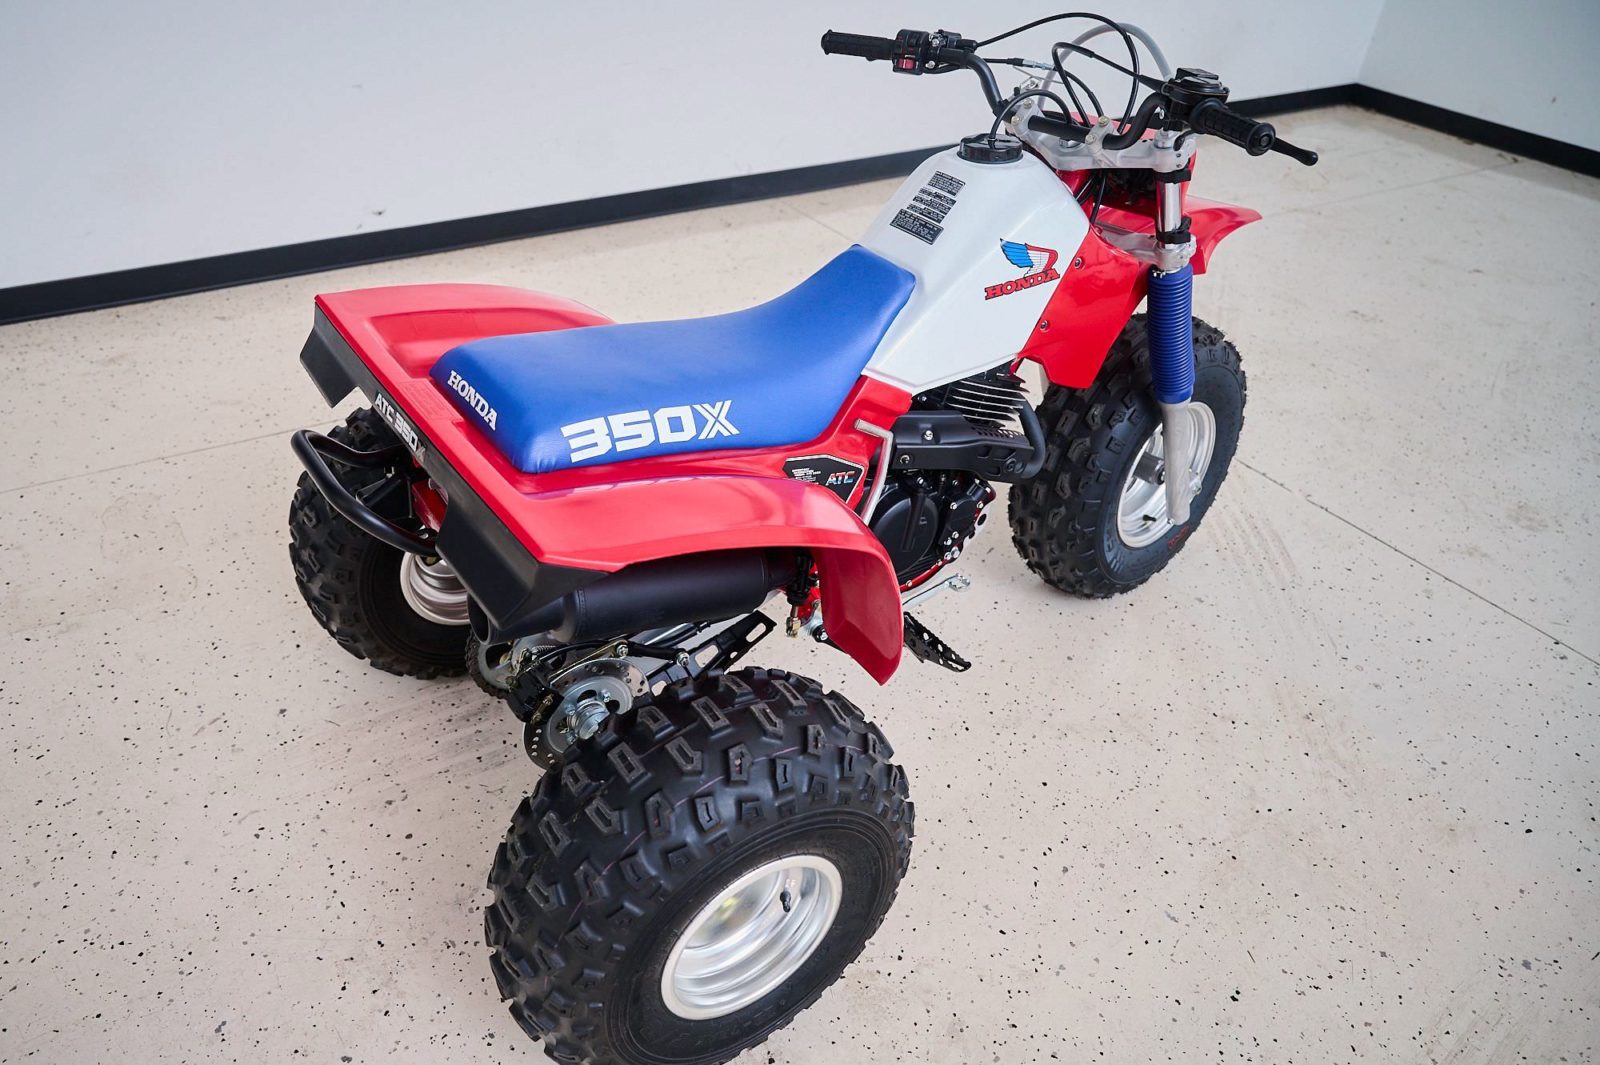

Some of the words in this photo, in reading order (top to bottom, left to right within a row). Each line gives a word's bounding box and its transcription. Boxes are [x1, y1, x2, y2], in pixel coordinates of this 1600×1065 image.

[984, 267, 1061, 301] HONDA
[374, 393, 395, 423] ATC
[394, 411, 427, 463] 350X
[447, 370, 498, 431] HONDA
[560, 399, 741, 464] 350X
[825, 470, 856, 486] ATC
